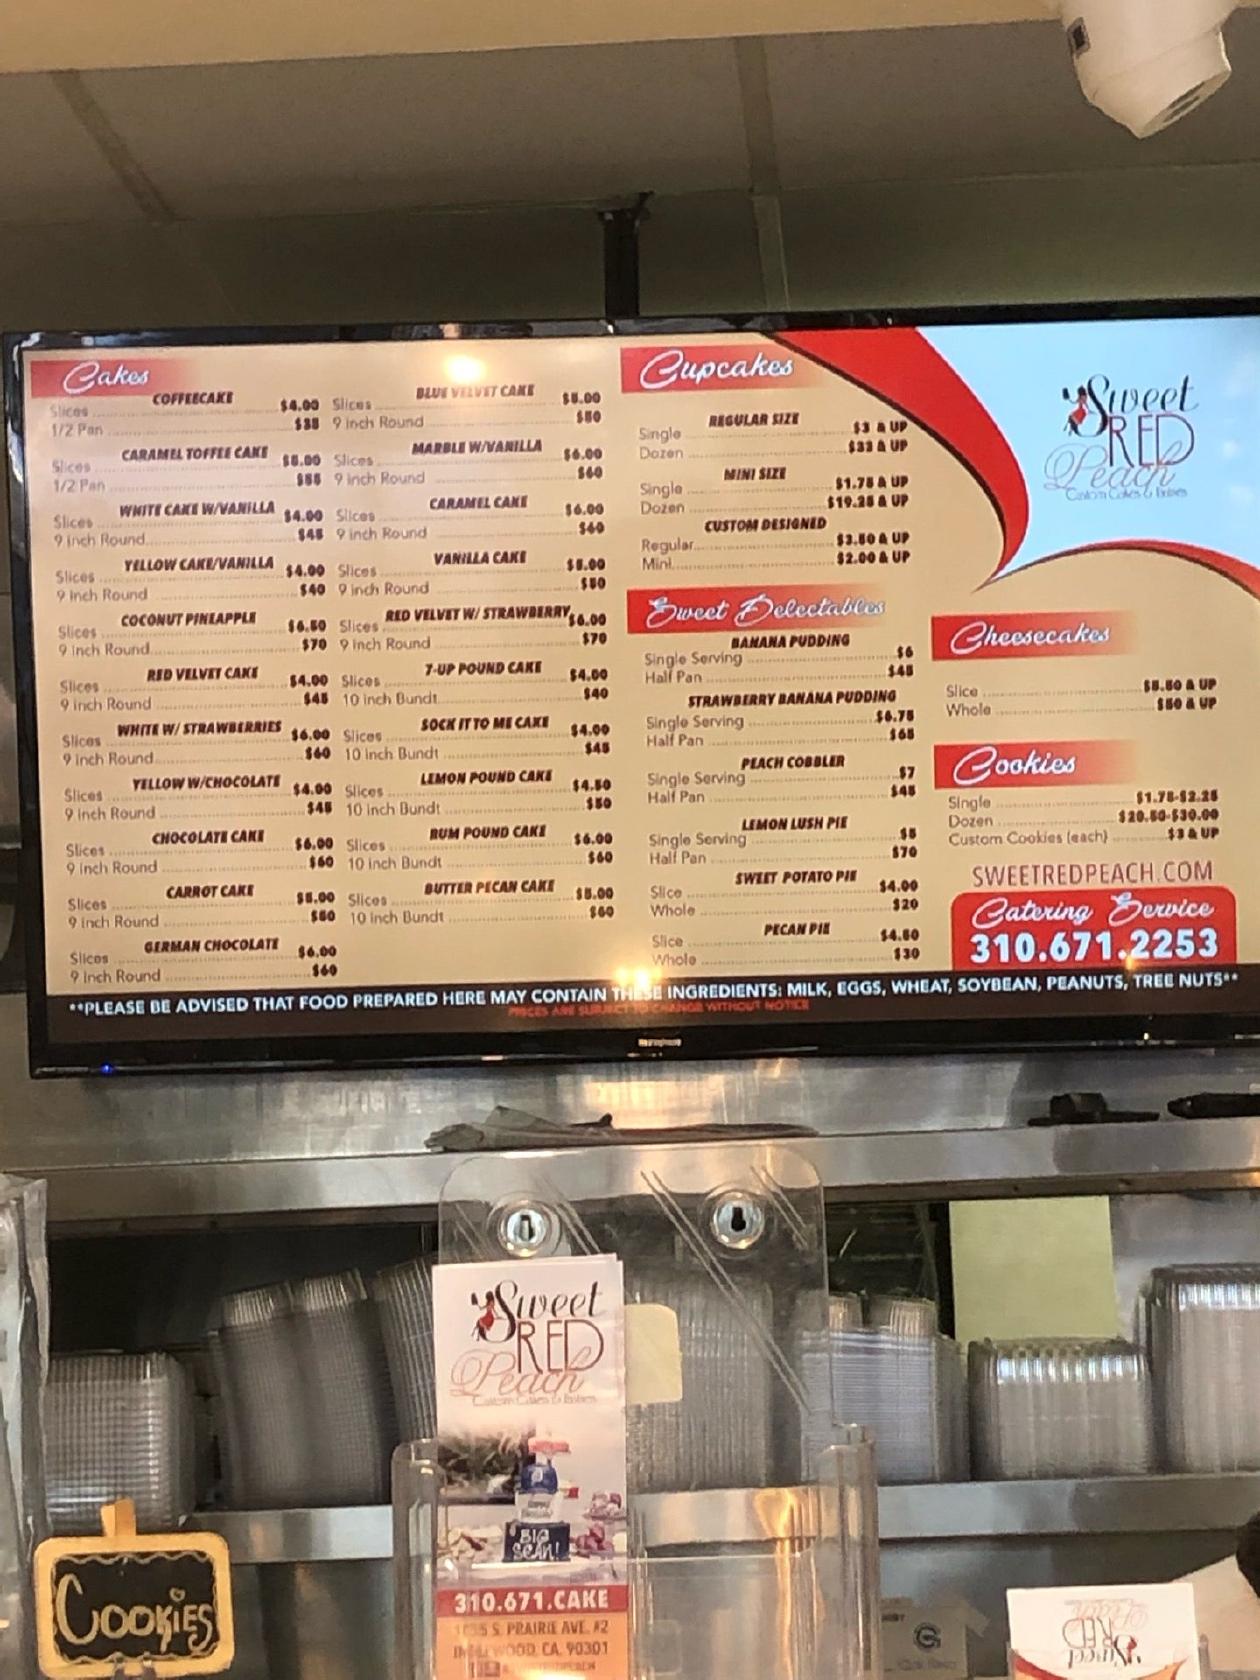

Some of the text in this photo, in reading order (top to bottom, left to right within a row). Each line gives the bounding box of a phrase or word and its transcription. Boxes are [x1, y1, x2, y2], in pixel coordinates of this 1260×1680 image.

[63, 360, 149, 394] Cakes
[640, 350, 794, 389] Cupcakes
[152, 392, 233, 405] COFFEECAKE
[416, 384, 534, 400] BLUE VELVET CAKE
[1072, 374, 1199, 437] Sweet
[709, 412, 800, 427] REGULAR SIZE
[412, 440, 542, 455] MARBLE W/VANILLA
[1109, 414, 1194, 468] RED
[122, 446, 268, 460] CARAMEL TOFFEE CAKE
[724, 467, 786, 480] MINI SIZE
[120, 501, 275, 517] WHITE CAKE W/VANILLA
[430, 496, 528, 510] CARAMEL CAKE
[704, 517, 826, 532] CUSTOM DESIGNED
[124, 556, 274, 572] YELLOW CAKE/VANILLA
[434, 551, 526, 566] VANILLA CAKE
[837, 552, 875, 565] $2.00
[892, 552, 910, 563] UP
[56, 564, 325, 584] Slices $4.00
[57, 584, 326, 602] 9 inch Round $40
[386, 609, 410, 622] RED
[414, 608, 460, 621] VELVET
[482, 605, 571, 619] STRAWBERRY
[646, 593, 885, 628] Sweet Delectables
[121, 612, 256, 626] COCONUT PINEAPPLE
[732, 634, 850, 649] BANANA PUDDING
[950, 621, 1110, 654] Cheesecakes
[644, 652, 742, 668] Single Serving
[147, 666, 258, 682] RED VELVET CAKE
[425, 661, 542, 676] 7-UP POUND CAKE
[645, 671, 702, 684] Half Pan
[688, 690, 896, 708] STRAWBERRY BANANA PUDDING
[946, 684, 978, 698] Slice
[118, 724, 159, 736] WHITE
[183, 720, 282, 734] STRAWBERRIES
[422, 718, 456, 731] SOCK
[492, 717, 512, 730] ME
[516, 716, 549, 728] CAKE
[741, 755, 845, 770] PEACH COBBLER
[953, 746, 1076, 786] Cookies
[132, 775, 280, 791] YELLOW W/CHOCOLATE
[420, 770, 552, 785] LEMON POUND CAKE
[742, 816, 848, 830] LEMON LUSH PIE
[948, 814, 993, 828] Dozen
[152, 830, 264, 844] CHOCOLATE CAKE
[430, 825, 546, 840] RUM POUND CAKE
[949, 829, 1108, 846] Custom Cookies (each)
[736, 870, 857, 884] SWEET POTATO PIE
[972, 861, 1213, 887] SWEETREDPEACH.COM
[166, 884, 254, 899] CARROT CAKE
[424, 880, 554, 895] BUTTER PECAN CAKE
[651, 898, 918, 917] Whole $20
[972, 892, 1214, 929] Catering Service
[350, 910, 444, 924] 10 inch Bundt
[764, 922, 830, 936] PECAN PIE
[144, 938, 279, 954] GERMAN CHOCOLATE
[970, 928, 1218, 963] 310.671.2253
[70, 946, 336, 965] Slices $6.00
[150, 999, 171, 1014] BE
[176, 997, 249, 1013] ADVISED
[253, 996, 293, 1011] THAT
[300, 994, 347, 1009] FOOD
[354, 991, 438, 1008] PREPARED
[443, 990, 486, 1006] HERE
[491, 989, 527, 1005] MAY
[531, 988, 606, 1003] CONTAIN
[611, 985, 662, 1002] THESE
[668, 983, 782, 1000] INGREDIENTS:
[788, 982, 832, 998] MILK,
[838, 980, 886, 996] EGGS,
[892, 978, 952, 994] WHEAT,
[958, 975, 1041, 993] SOYBEAN,
[1047, 974, 1128, 991] PEANUTS,
[1133, 974, 1174, 988] TREE
[508, 1005, 548, 1017] PRICES
[552, 1005, 575, 1016] ARE
[708, 1000, 760, 1012] WITHOUT
[765, 1000, 810, 1010] NOTICE
[478, 1280, 607, 1343] Sweet
[517, 1319, 604, 1374] RED
[455, 1590, 608, 1614] 310.671.CAKE
[507, 1620, 557, 1635] PRAIRIE
[567, 1642, 608, 1655] 90301
